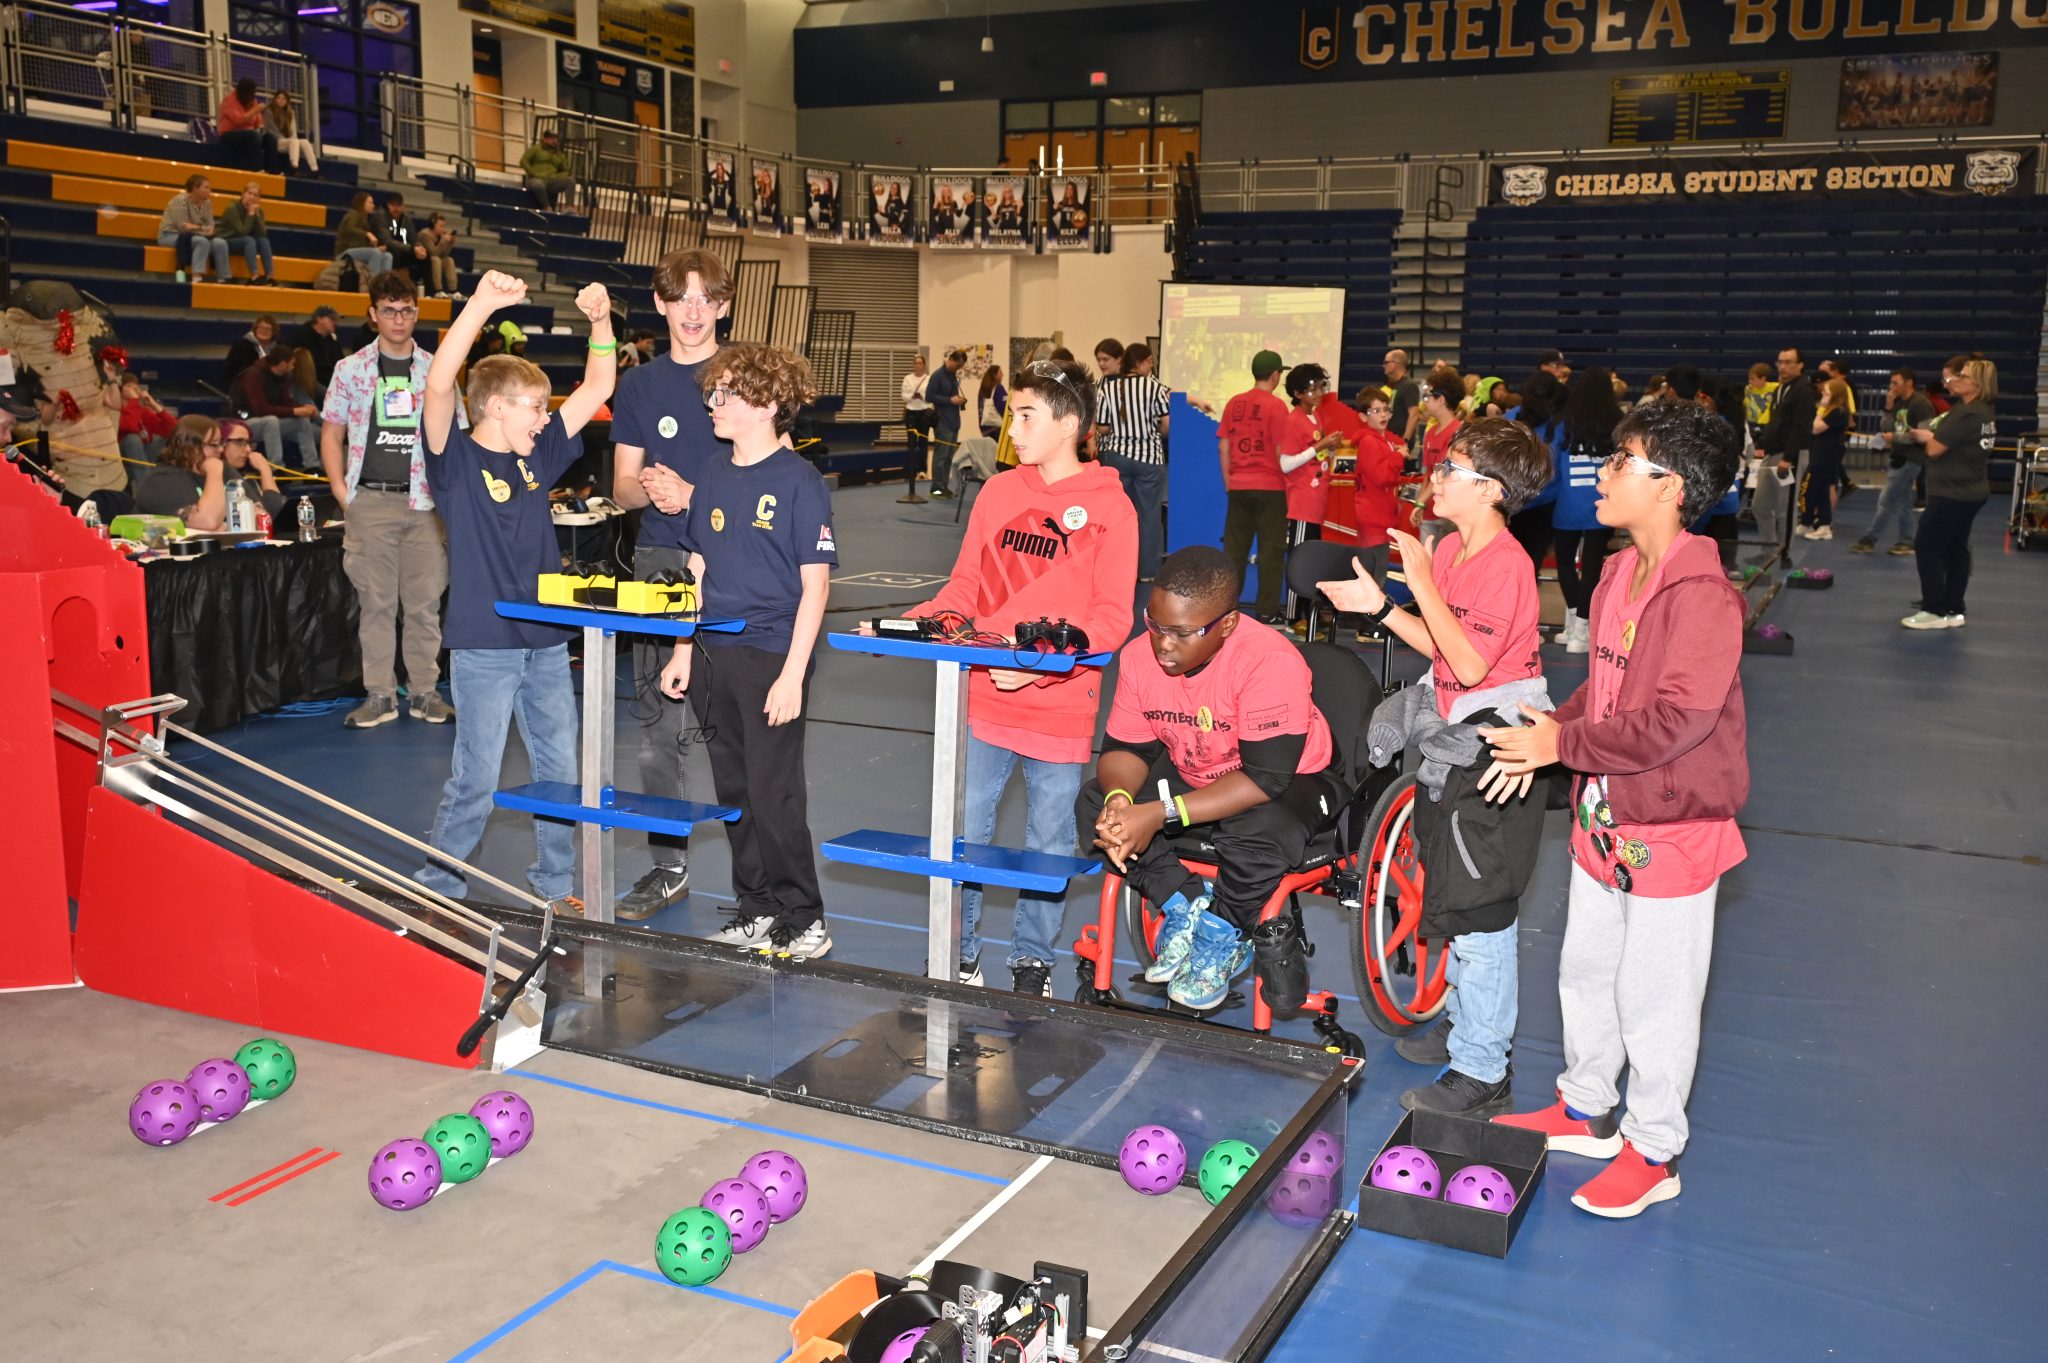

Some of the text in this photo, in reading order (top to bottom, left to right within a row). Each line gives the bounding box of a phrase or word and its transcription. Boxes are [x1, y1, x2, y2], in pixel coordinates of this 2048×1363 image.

[1354, 0, 1691, 65] CHELSEA
[1555, 164, 1954, 197] CHELSEA STUDENT SECTION
[376, 431, 416, 445] DECOD
[756, 494, 777, 521] C
[1001, 528, 1058, 560] PUMA
